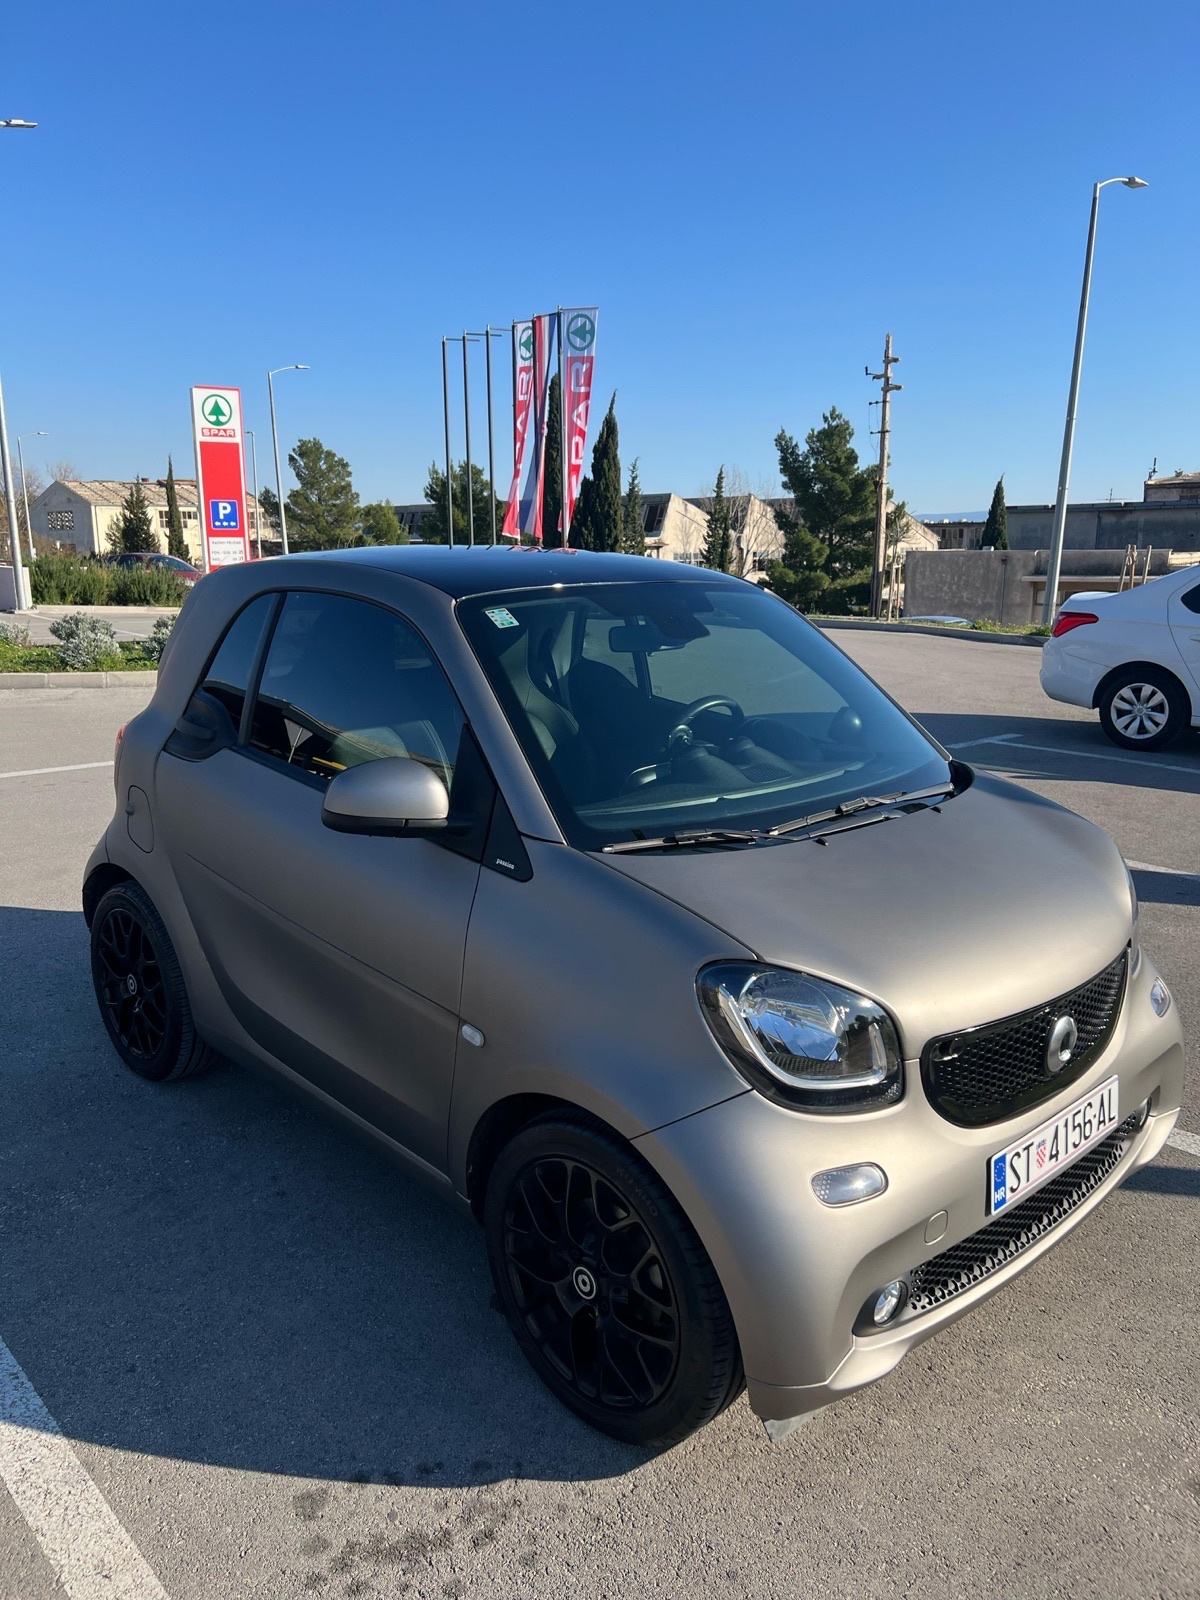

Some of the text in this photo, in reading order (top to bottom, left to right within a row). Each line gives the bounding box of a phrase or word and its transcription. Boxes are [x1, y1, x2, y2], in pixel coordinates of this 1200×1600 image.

[202, 428, 235, 437] SPAR
[218, 502, 232, 519] P
[1009, 1141, 1034, 1194] ST
[994, 1186, 1006, 1203] HR
